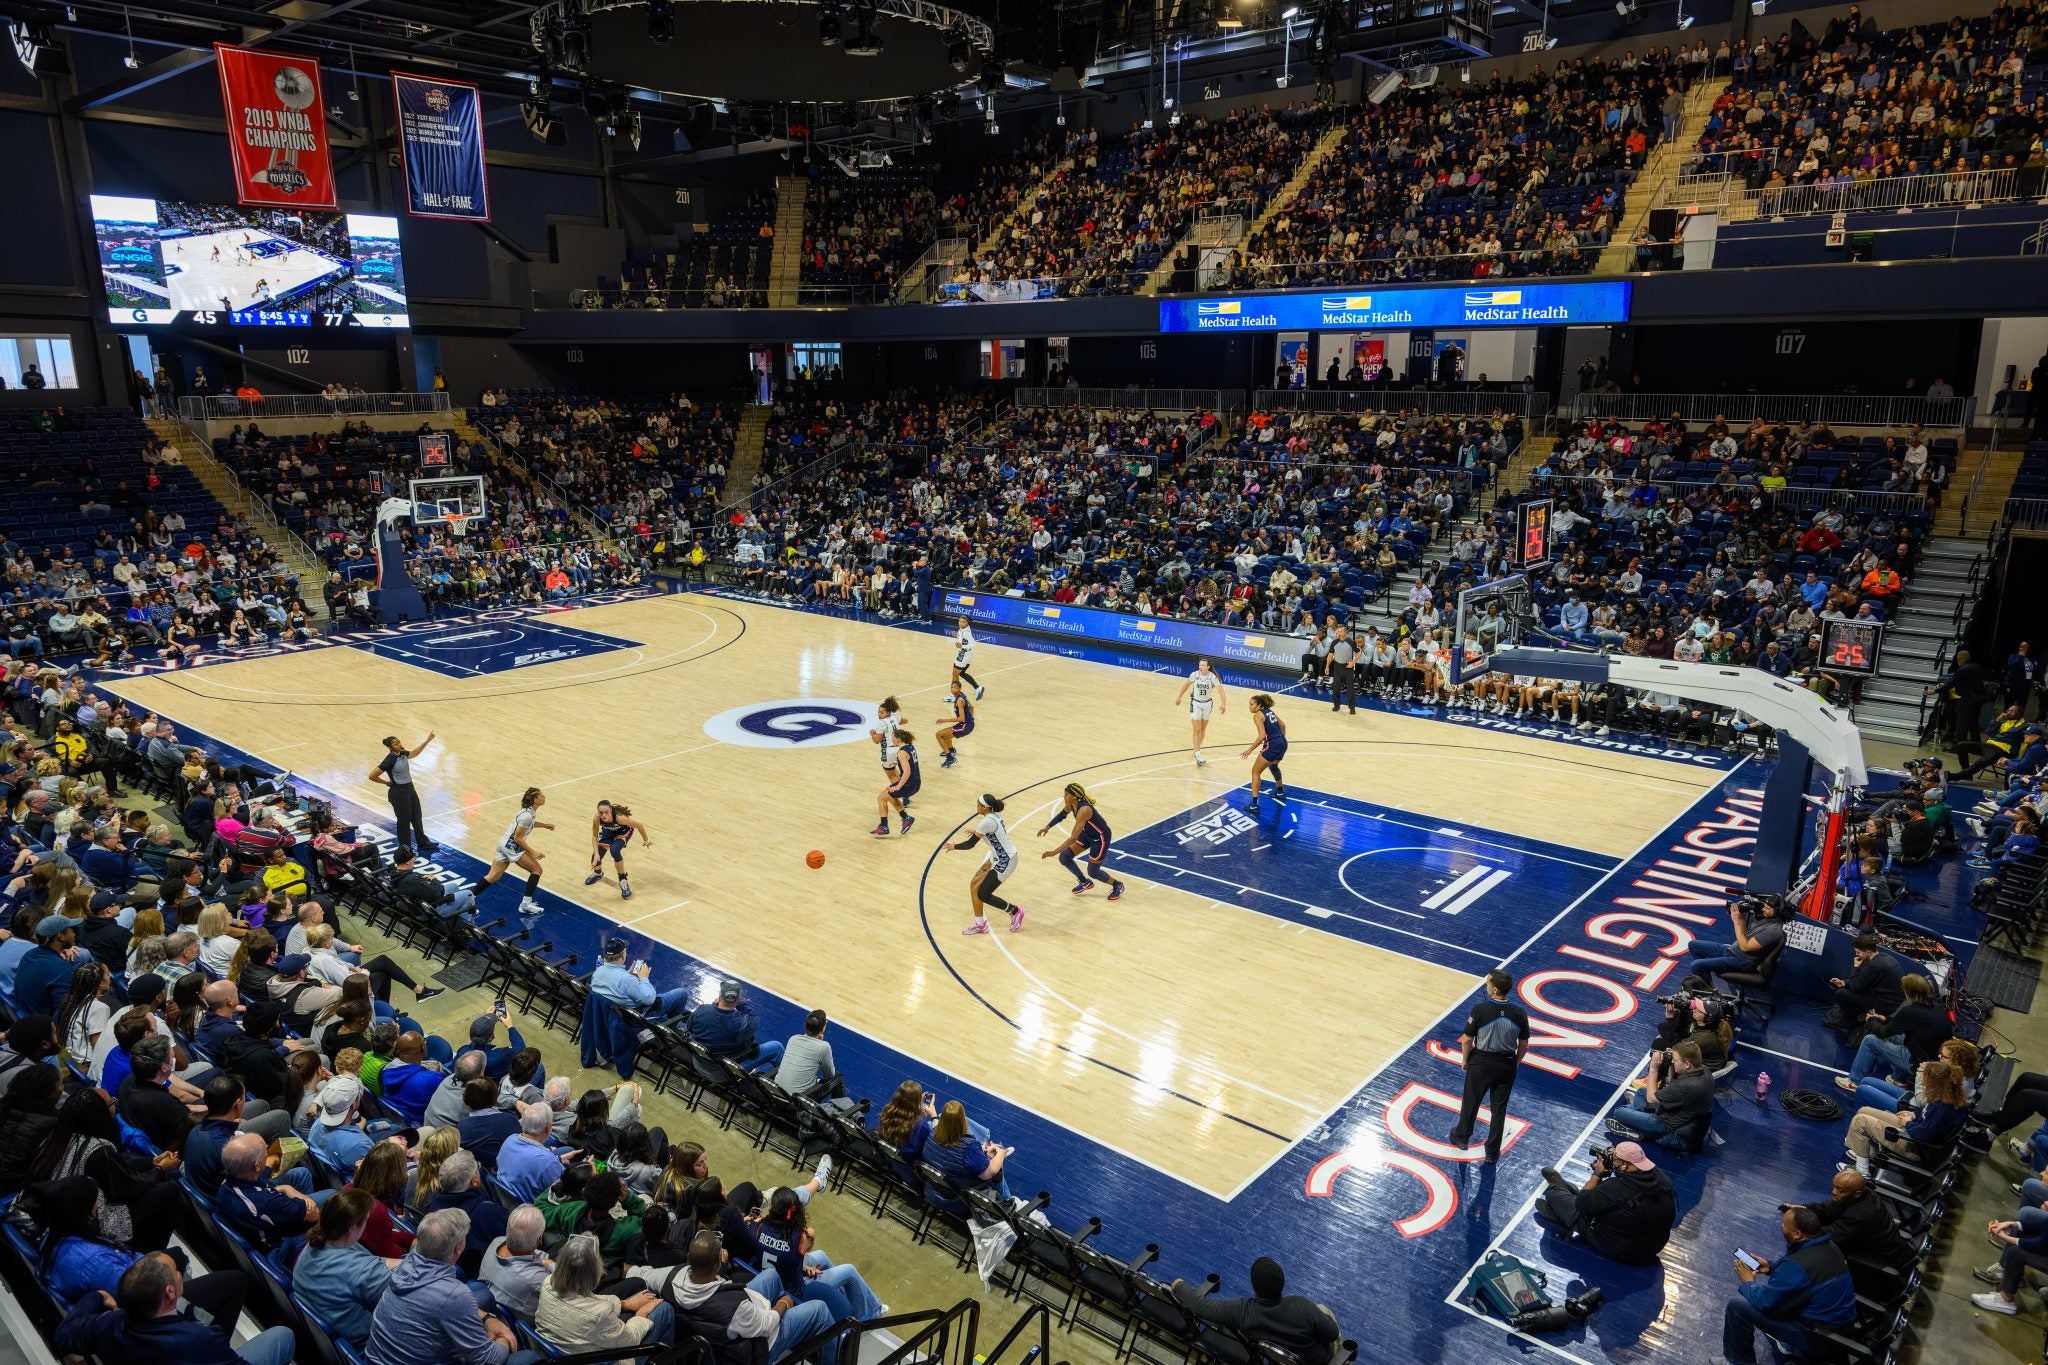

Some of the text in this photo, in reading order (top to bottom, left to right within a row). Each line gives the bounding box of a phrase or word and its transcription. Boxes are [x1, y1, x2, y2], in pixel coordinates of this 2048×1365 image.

[1522, 33, 1546, 52] 204
[244, 107, 312, 132] 2019 WNBA
[245, 128, 317, 151] CHAMPIONS
[423, 192, 474, 210] HALL of FAME
[676, 190, 690, 204] 201
[132, 309, 344, 327] G 45 6:45 77
[1198, 315, 1277, 328] MedStar Health
[1323, 311, 1412, 324] MedStar Health
[1465, 306, 1569, 321] MedStar Health
[1140, 344, 1157, 359] 105
[1410, 341, 1432, 357] 106
[1775, 334, 1806, 354] 107
[286, 349, 310, 364] 102
[567, 349, 584, 363] 103
[924, 347, 938, 360] 104
[426, 447, 445, 464] 25
[1526, 527, 1543, 559] 25
[597, 588, 664, 604] DC
[943, 604, 996, 619] MedStar Health
[1026, 616, 1085, 633] MedStar Health
[1117, 630, 1183, 648] MedStar Health
[1223, 645, 1296, 665] MedStar Health
[1835, 643, 1864, 665] 25
[736, 705, 866, 744] G
[1447, 714, 1722, 765] @TheEventsDC
[1174, 807, 1244, 845] EAST
[1204, 815, 1260, 845] BIG
[759, 1232, 791, 1252] BUECKERS
[762, 1251, 778, 1271] 5
